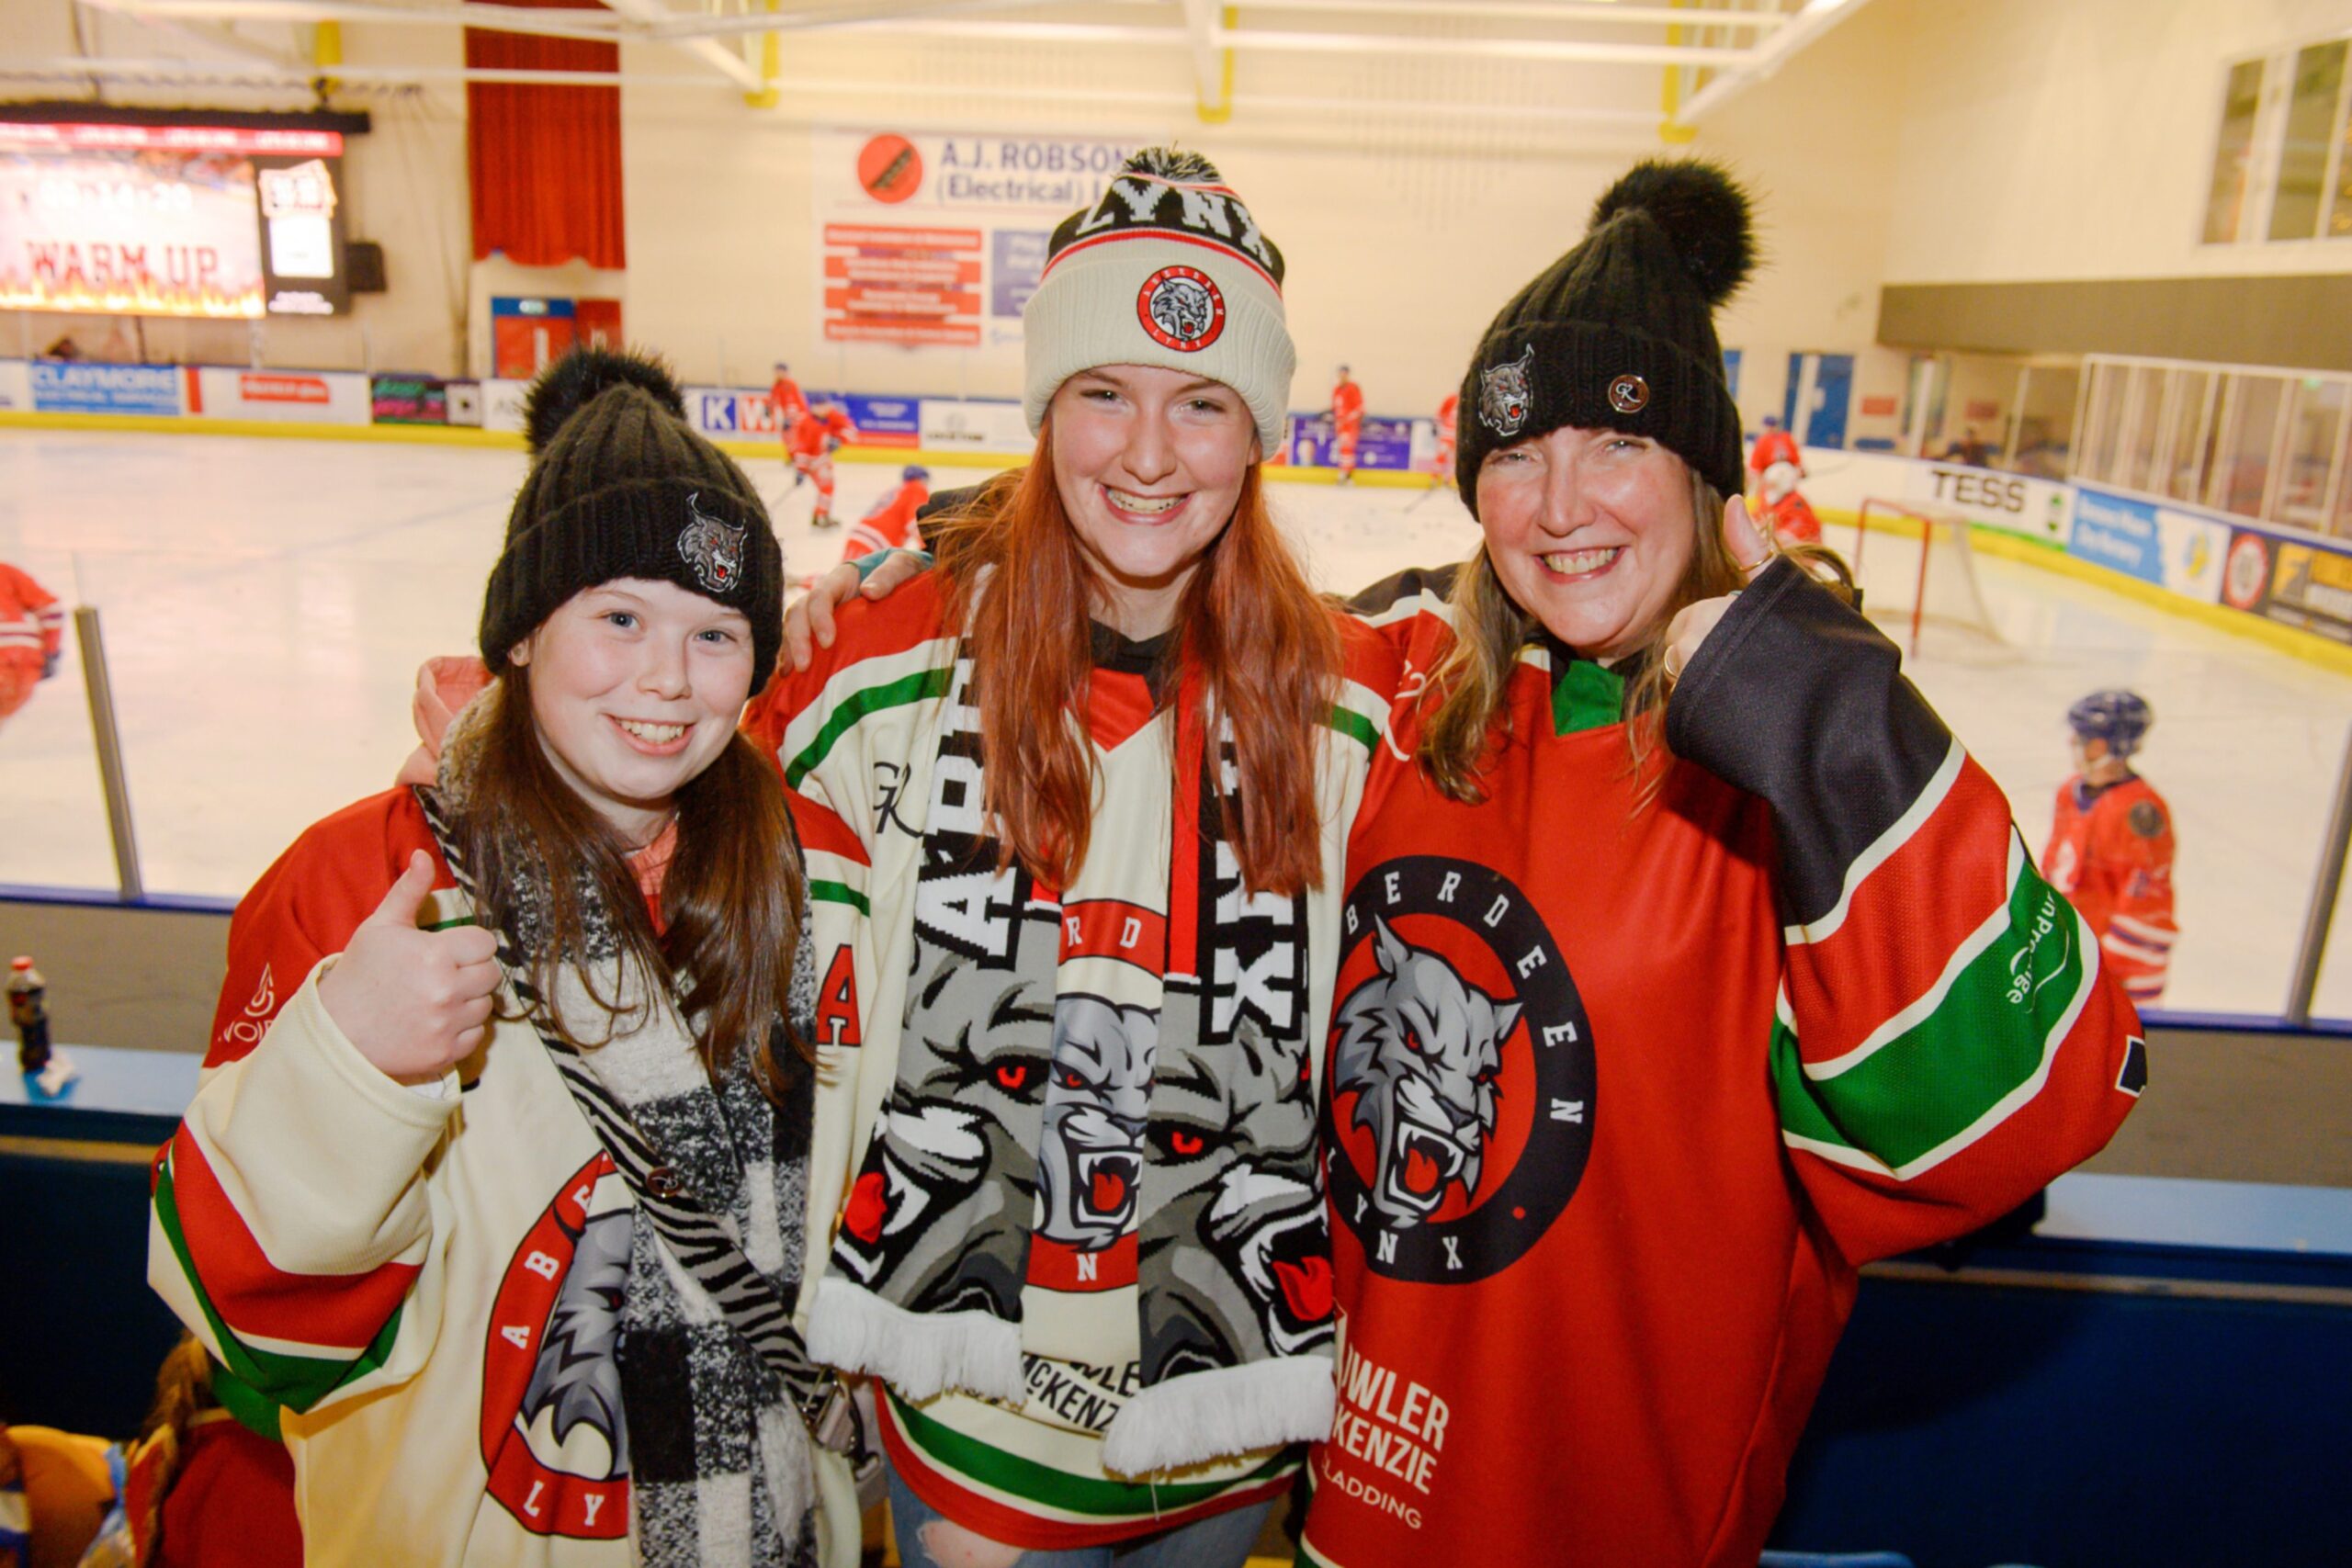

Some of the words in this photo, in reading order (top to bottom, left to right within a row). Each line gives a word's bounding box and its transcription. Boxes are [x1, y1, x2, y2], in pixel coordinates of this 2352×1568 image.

[940, 141, 991, 170] A.J.
[936, 174, 1085, 208] (Electrical)
[1076, 179, 1274, 269] LYNX
[28, 239, 149, 287] WARM
[166, 244, 220, 288] UP
[1932, 469, 2025, 513] TESS
[816, 942, 861, 1047] A
